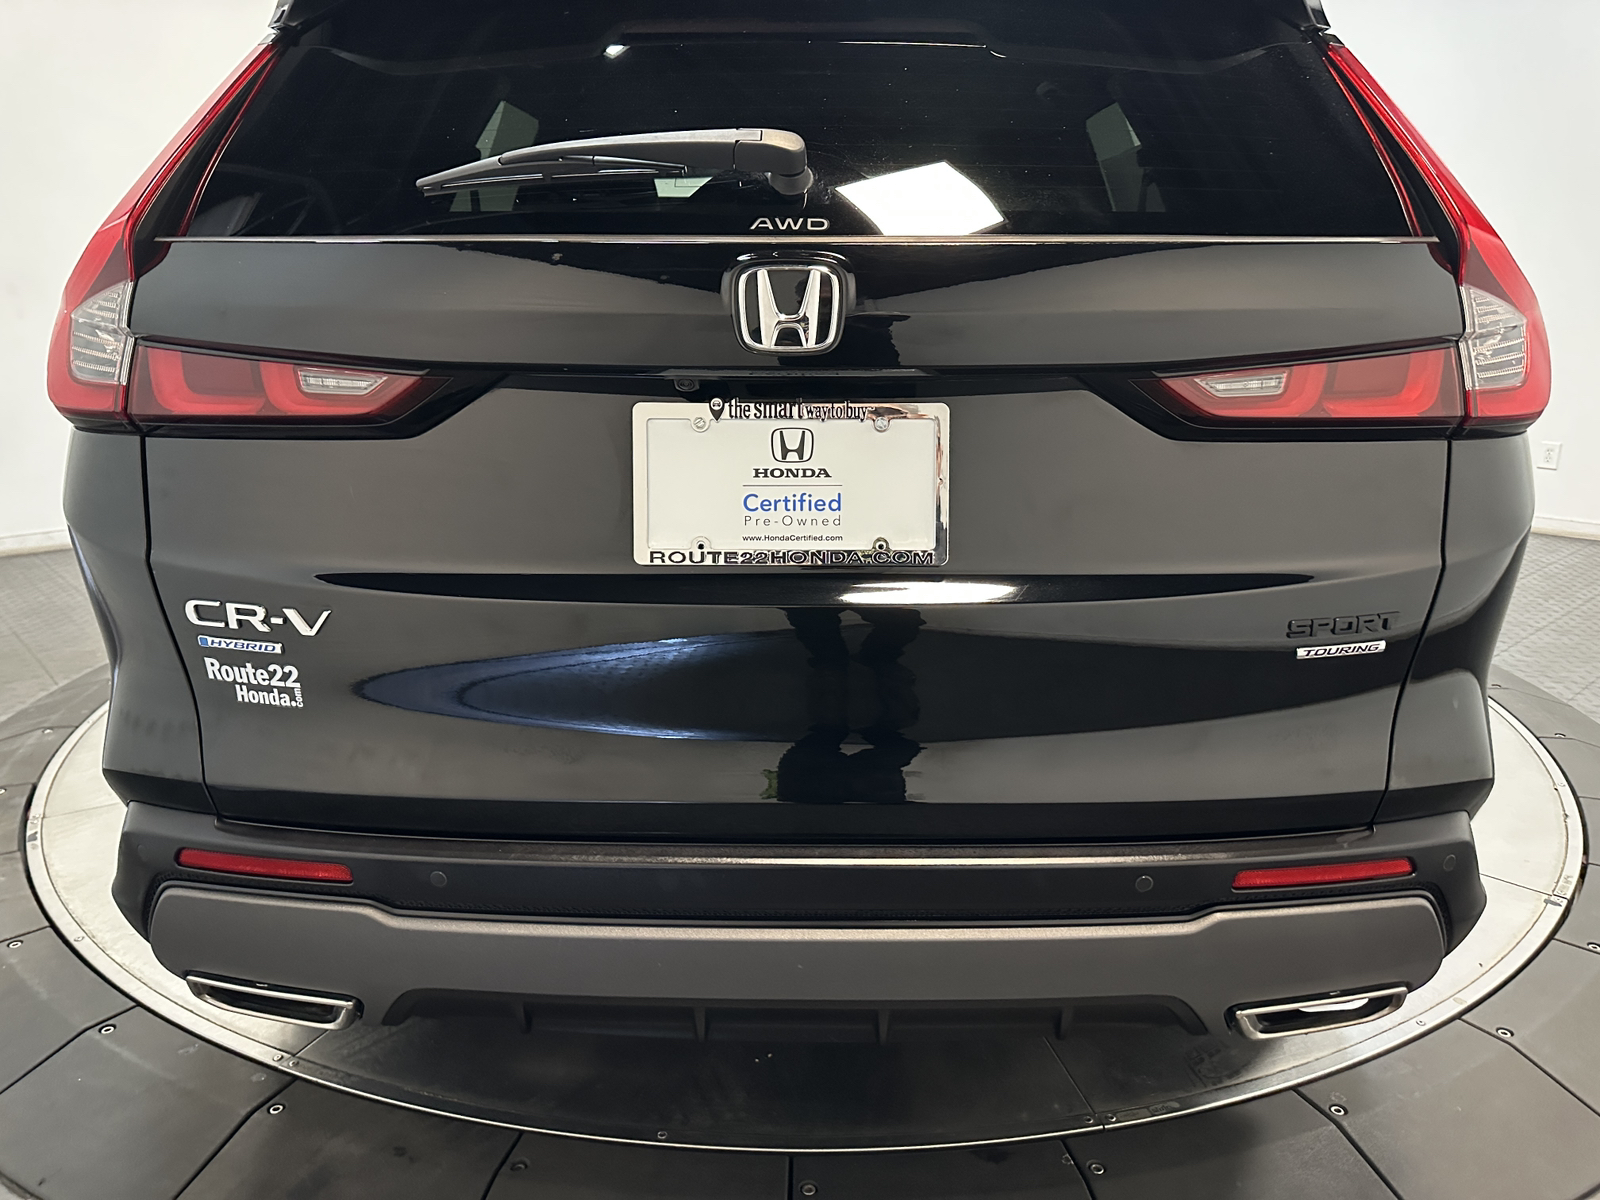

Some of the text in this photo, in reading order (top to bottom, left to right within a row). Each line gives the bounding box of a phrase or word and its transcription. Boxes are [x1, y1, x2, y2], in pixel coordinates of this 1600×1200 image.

[750, 217, 830, 231] AWD
[728, 398, 751, 419] the
[754, 399, 803, 420] smart
[752, 468, 832, 479] HONDA
[743, 493, 842, 512] Certified
[744, 515, 841, 527] Pre-Owned
[742, 534, 843, 542] www.HondaCertified.com
[649, 550, 934, 565] ROUTE22HONDA.COM
[185, 599, 332, 636] CR-V
[1286, 611, 1399, 638] SPORT
[210, 640, 276, 652] HYBRID
[1303, 643, 1380, 657] TOURING
[204, 656, 301, 687] Route22
